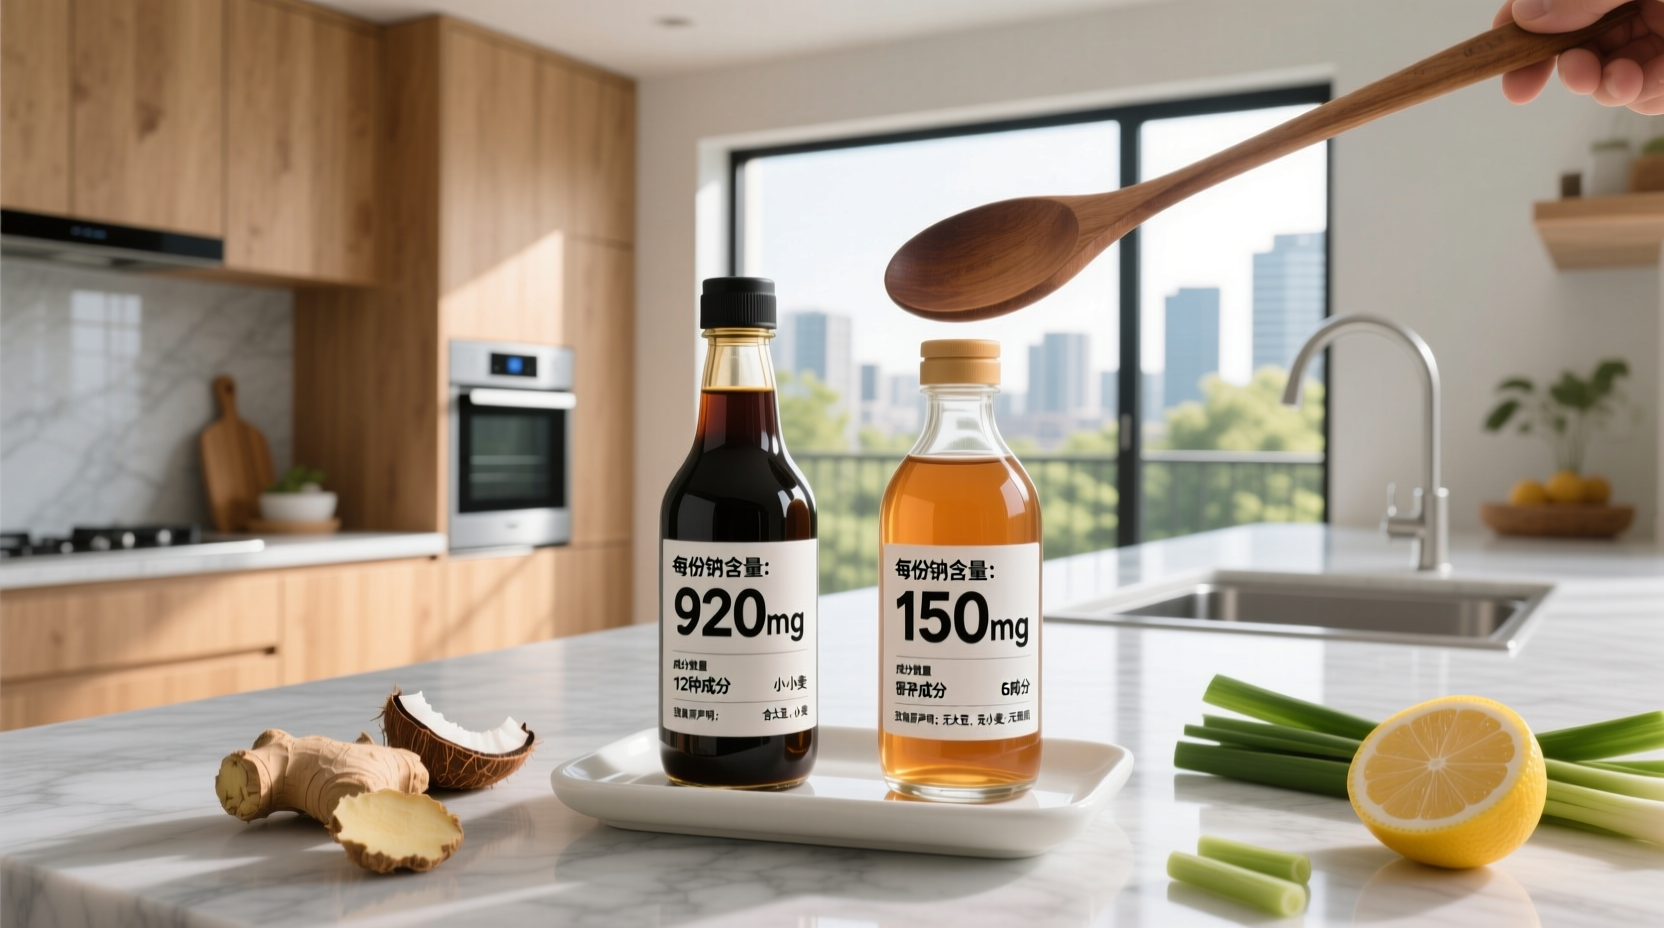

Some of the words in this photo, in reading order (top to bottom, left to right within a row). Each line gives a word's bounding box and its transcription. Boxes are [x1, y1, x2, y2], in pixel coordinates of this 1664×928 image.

[672, 554, 769, 578] 每份钠含量:
[895, 557, 995, 581] 每份钠含量:
[675, 587, 804, 642] 920mg
[896, 590, 1029, 648] 150mg
